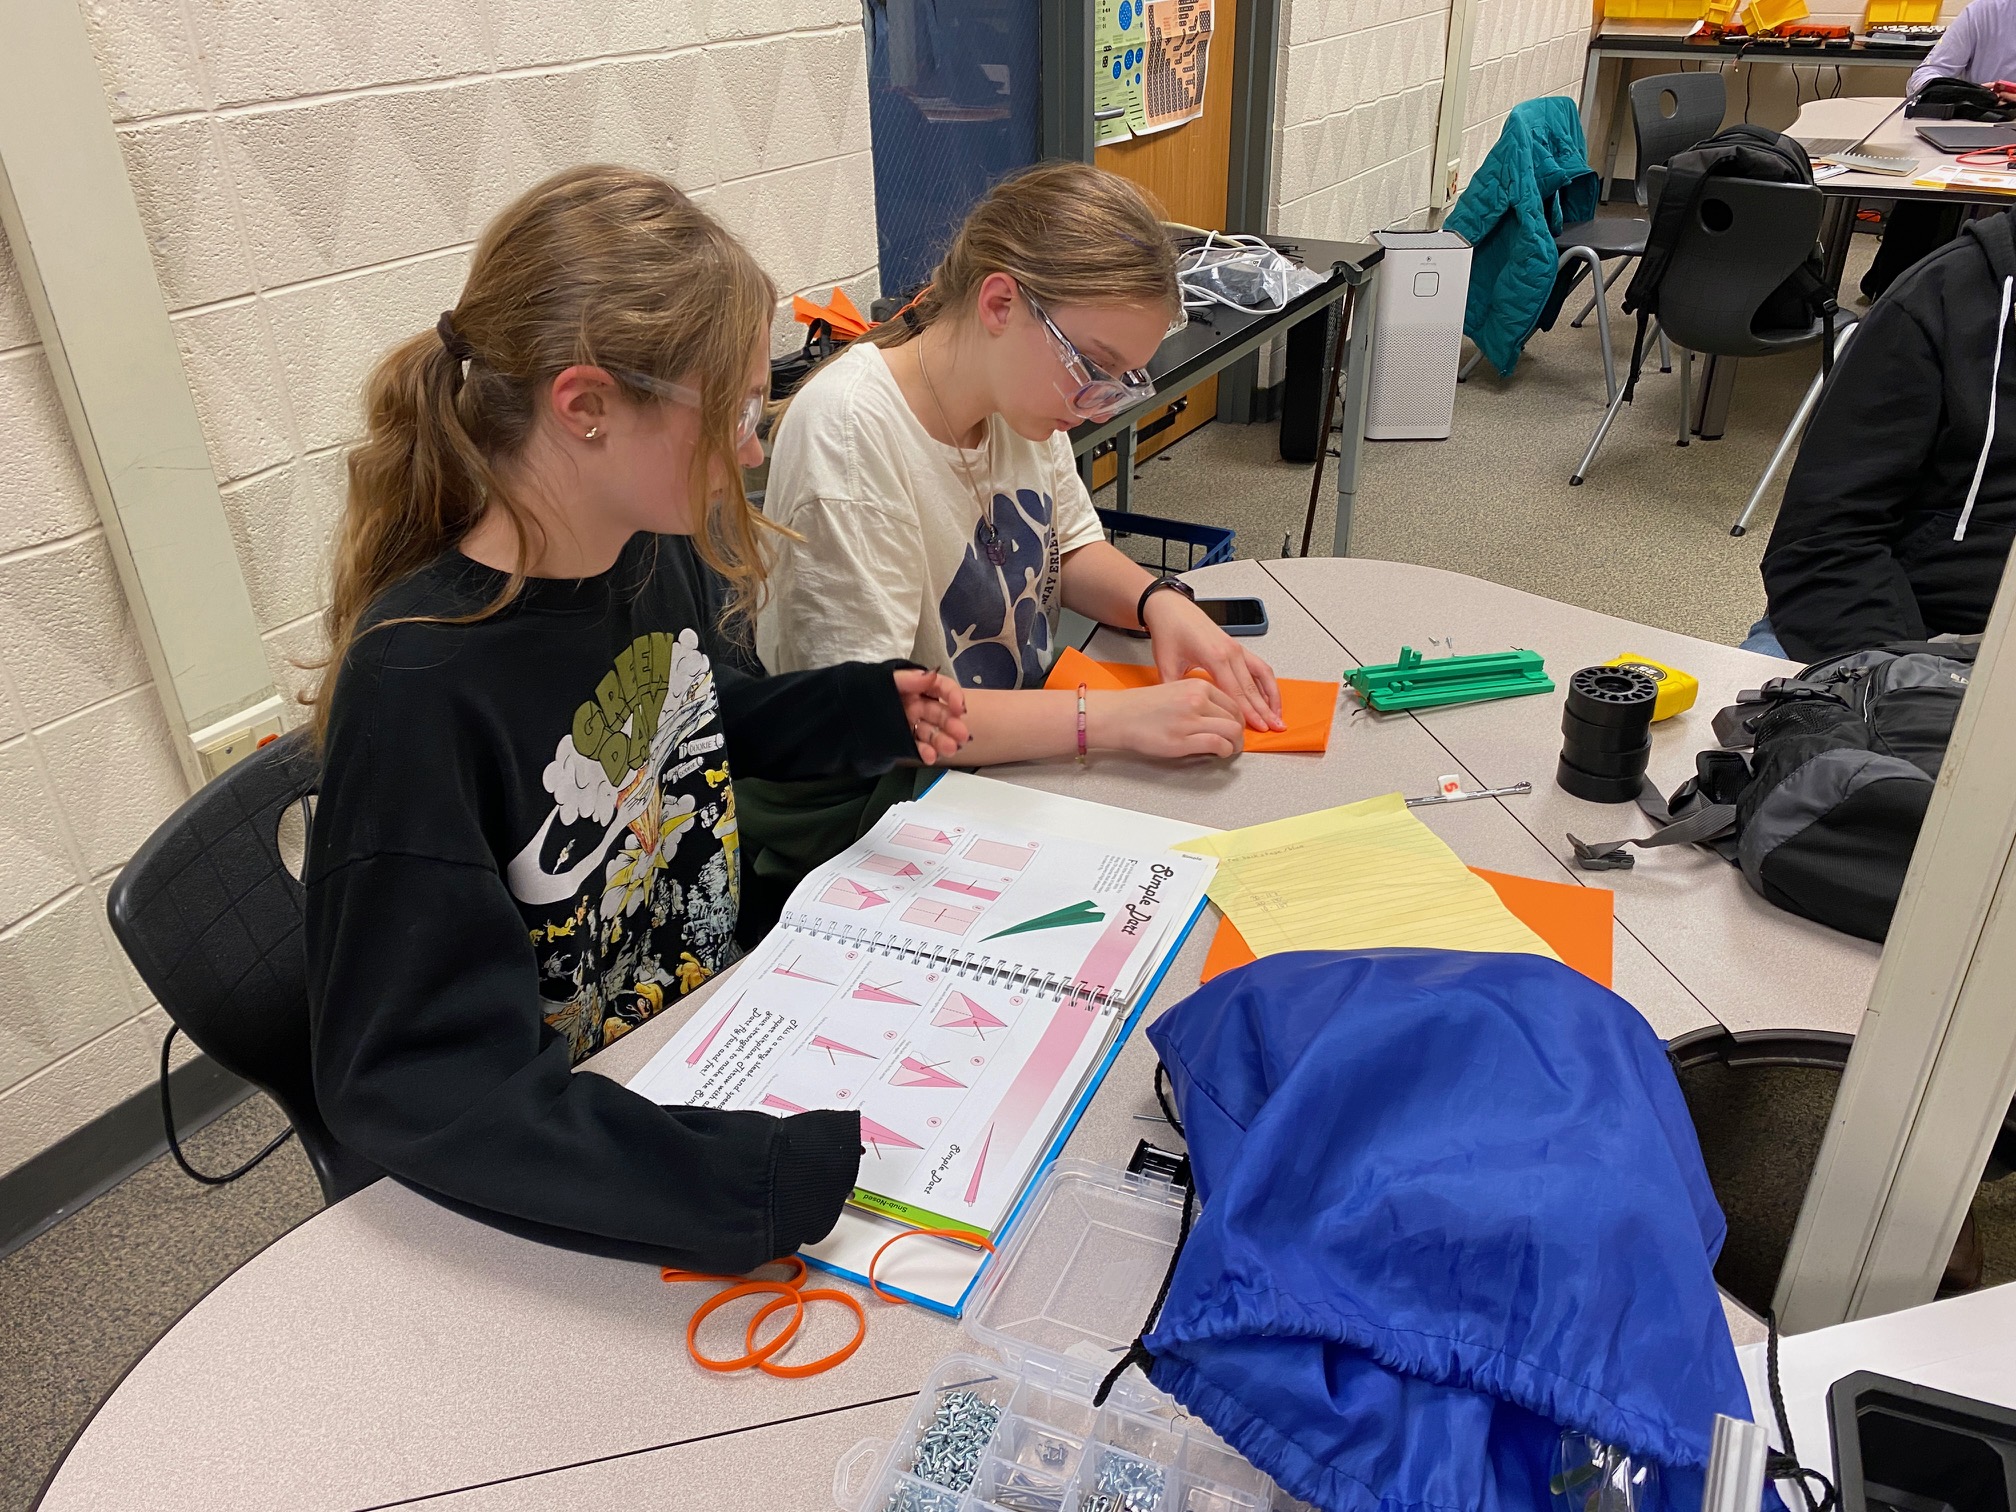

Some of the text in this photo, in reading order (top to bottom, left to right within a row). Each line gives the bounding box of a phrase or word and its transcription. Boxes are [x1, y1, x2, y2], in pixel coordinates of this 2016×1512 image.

[1042, 577, 1056, 605] MAY
[572, 631, 673, 761] GREEN
[599, 685, 669, 787] DAY
[1121, 863, 1174, 936] Simple Dart
[758, 1010, 773, 1027] your
[768, 1014, 785, 1033] paper
[782, 1019, 798, 1035] This
[701, 1007, 762, 1077] Dart fly fast and far!
[735, 1027, 760, 1052] strength
[729, 1052, 737, 1060] to
[757, 1047, 773, 1061] very
[712, 1060, 730, 1078] make
[723, 1061, 745, 1085] Throw
[747, 1062, 761, 1078] sleek
[702, 1078, 715, 1089] the
[709, 1085, 724, 1100] with
[733, 1077, 746, 1093] and
[713, 1091, 735, 1111] speed
[923, 1144, 961, 1195] Simple Dart
[863, 1194, 908, 1213] Snub-Nosed
